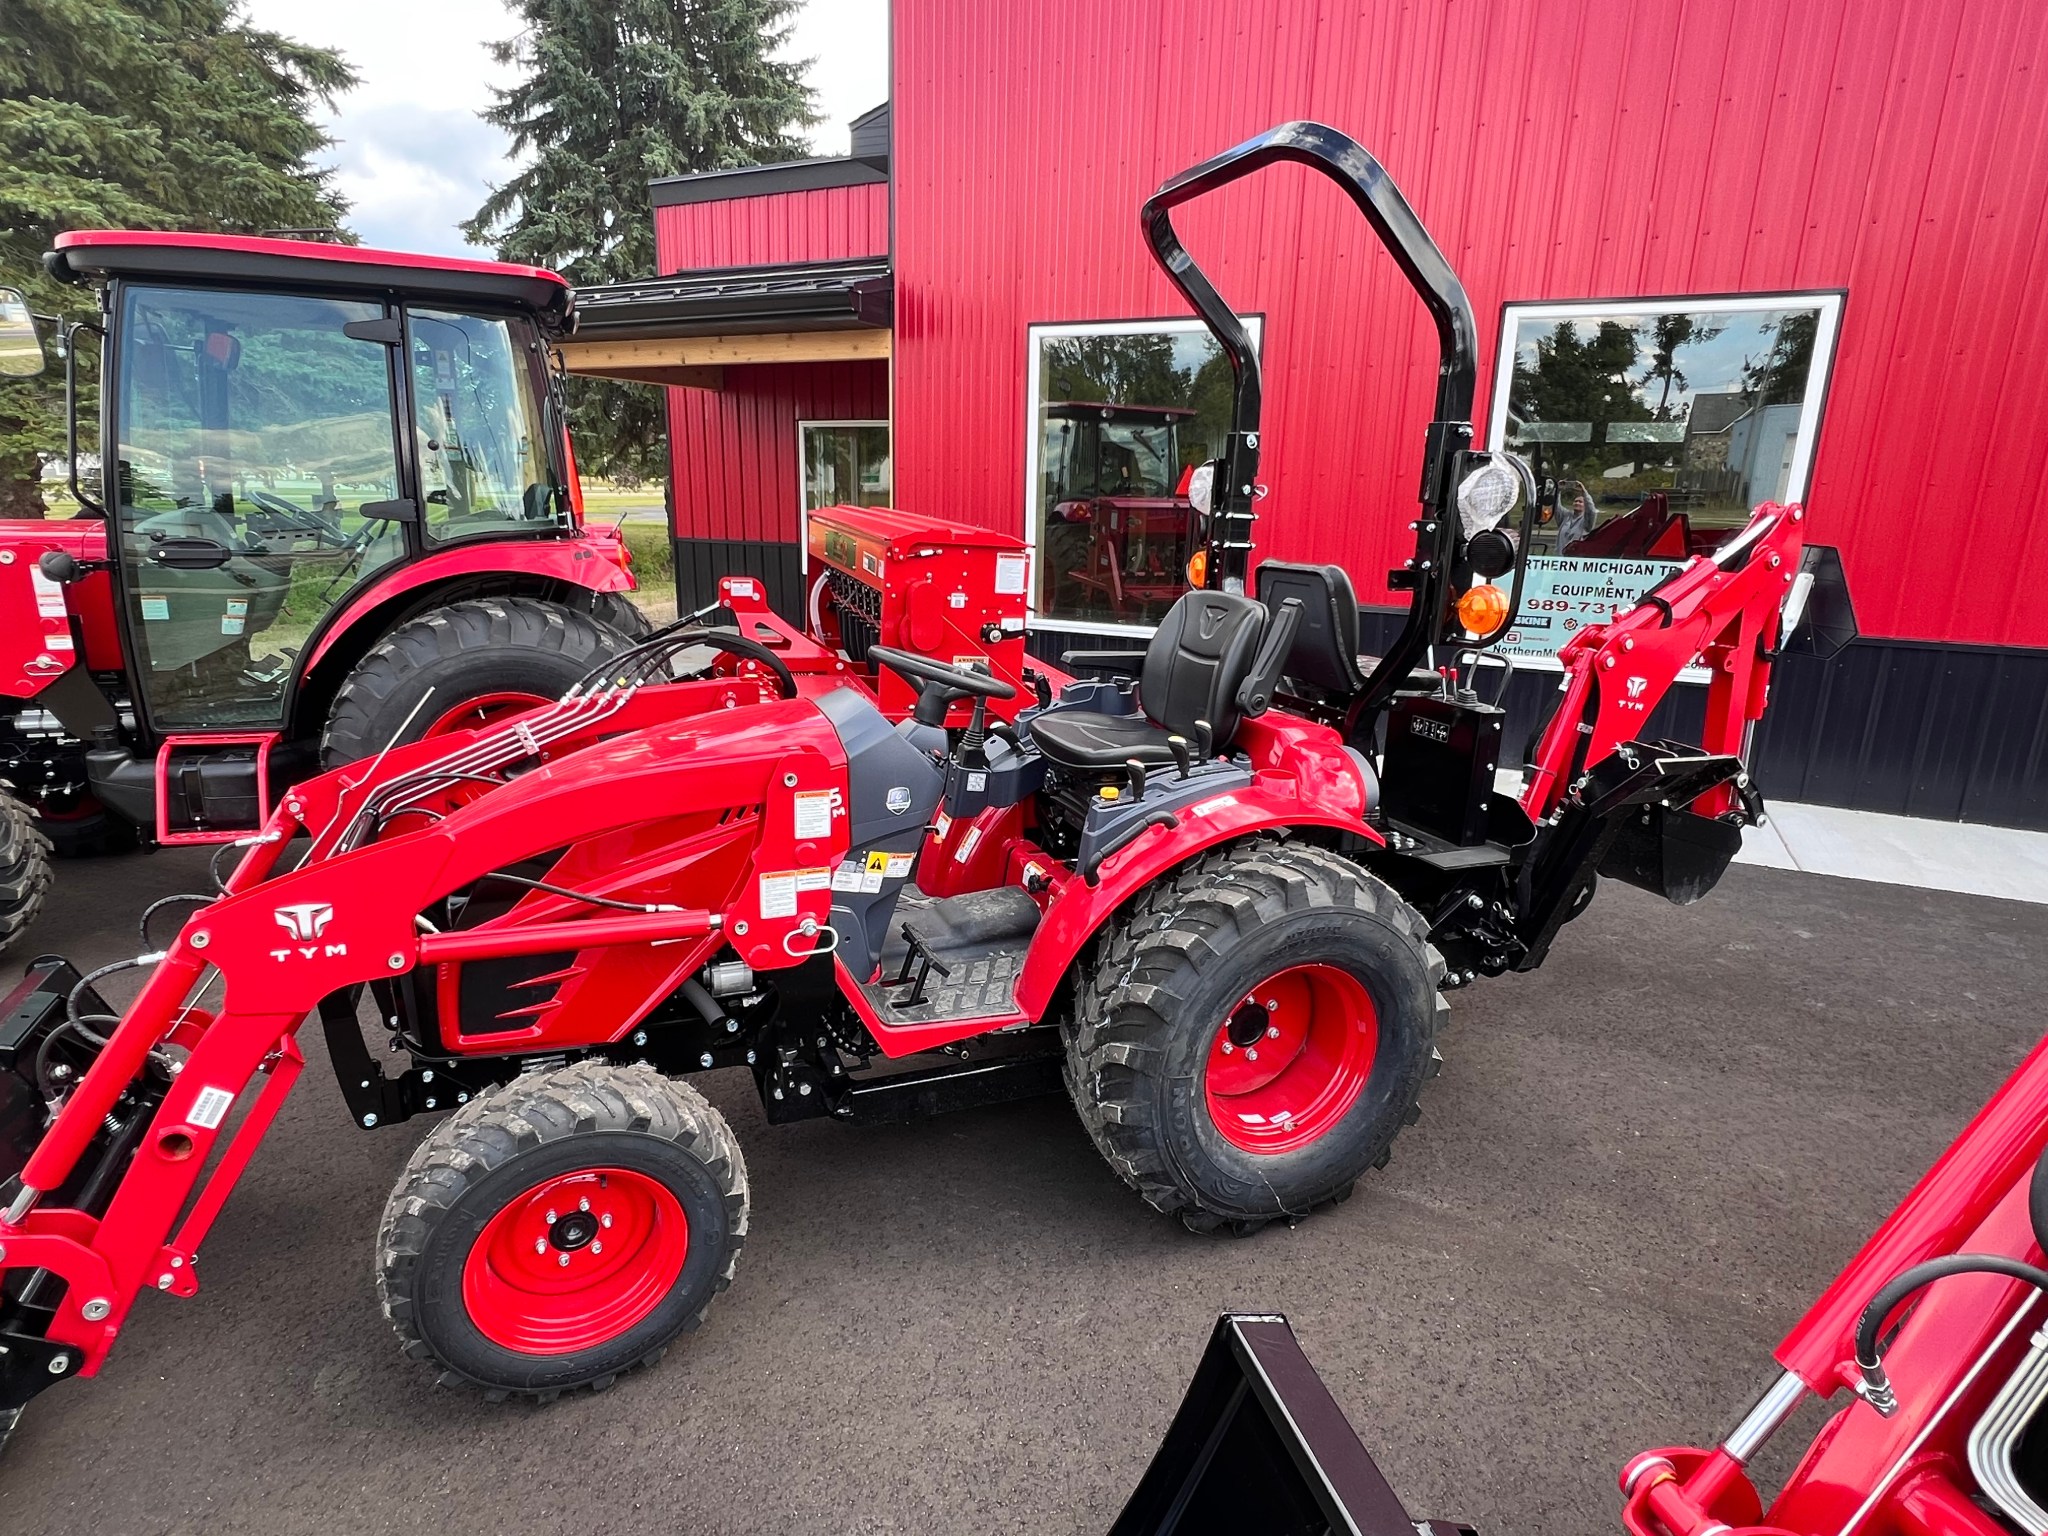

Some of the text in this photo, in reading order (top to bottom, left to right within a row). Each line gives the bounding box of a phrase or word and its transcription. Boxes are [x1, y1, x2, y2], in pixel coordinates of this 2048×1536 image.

[1526, 559, 1578, 572] RTHERN
[1582, 562, 1655, 576] MICHIGAN
[1606, 576, 1614, 586] &
[1552, 585, 1635, 601] EQUIPMENT,
[1527, 599, 1620, 615] 989-731
[1514, 616, 1548, 626] SKINE
[1493, 645, 1557, 659] NorthernMi
[1618, 700, 1645, 711] TYM
[269, 944, 347, 962] TYM
